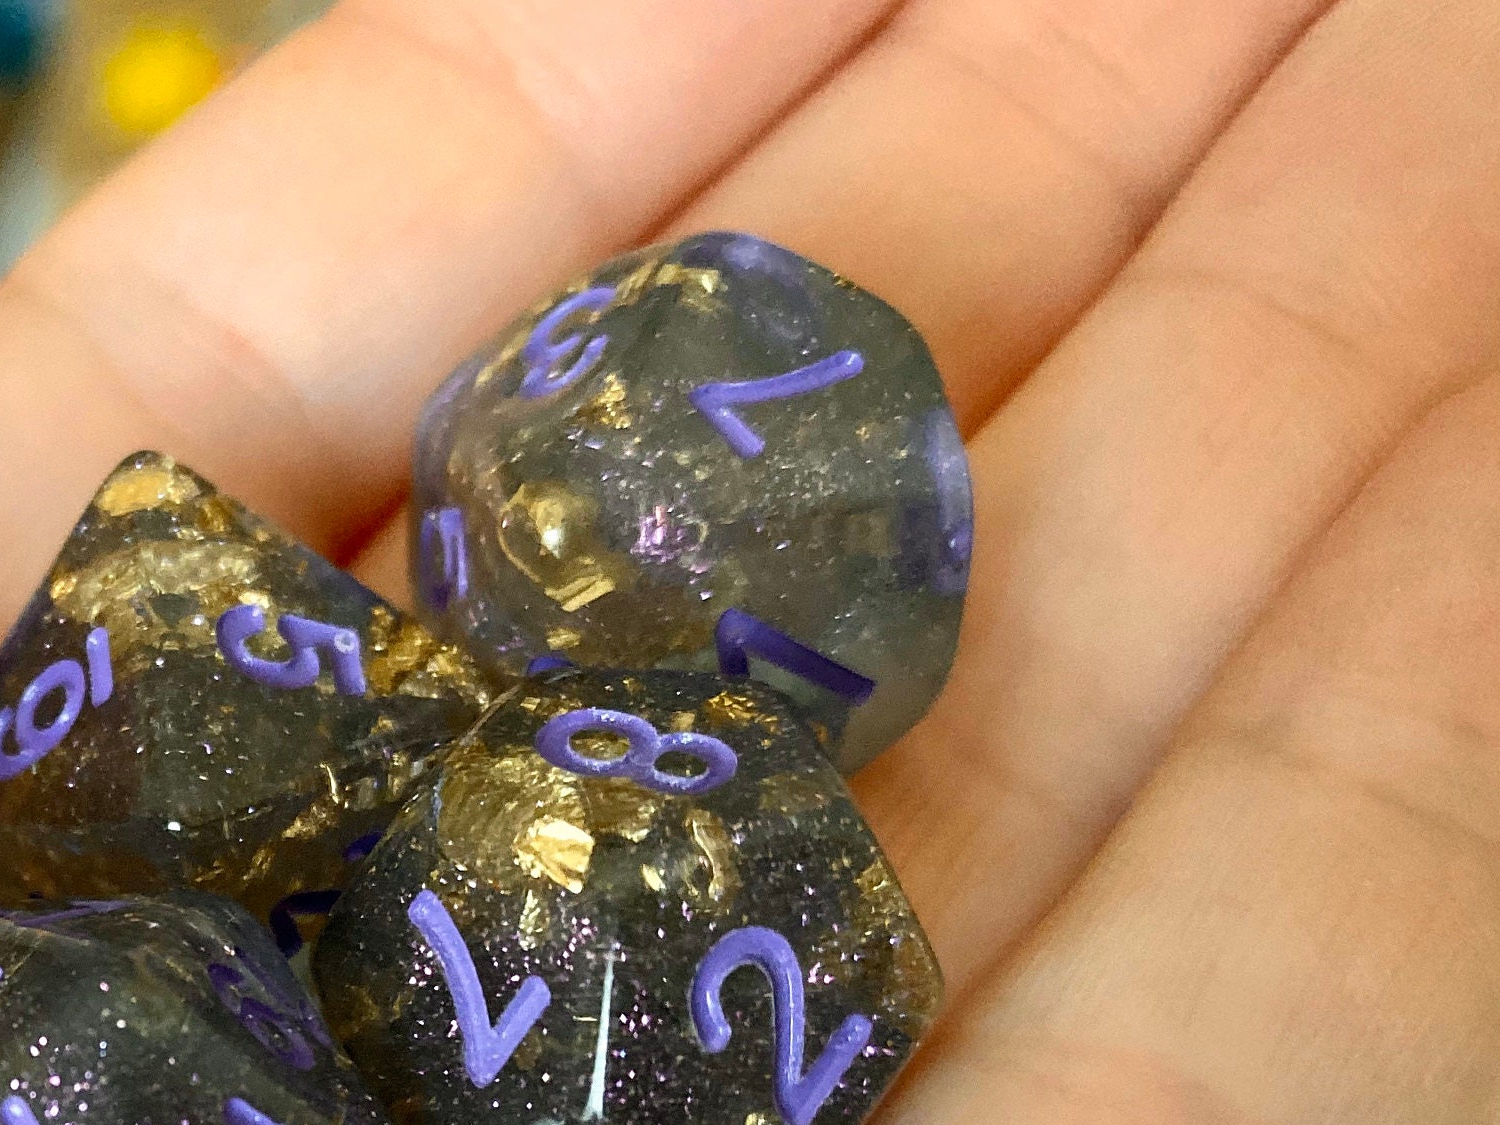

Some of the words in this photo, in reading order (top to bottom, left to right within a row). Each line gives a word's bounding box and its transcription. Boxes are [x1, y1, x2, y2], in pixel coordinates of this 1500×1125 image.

[518, 285, 617, 398] 3
[216, 603, 367, 696] 5
[536, 707, 739, 796] 8
